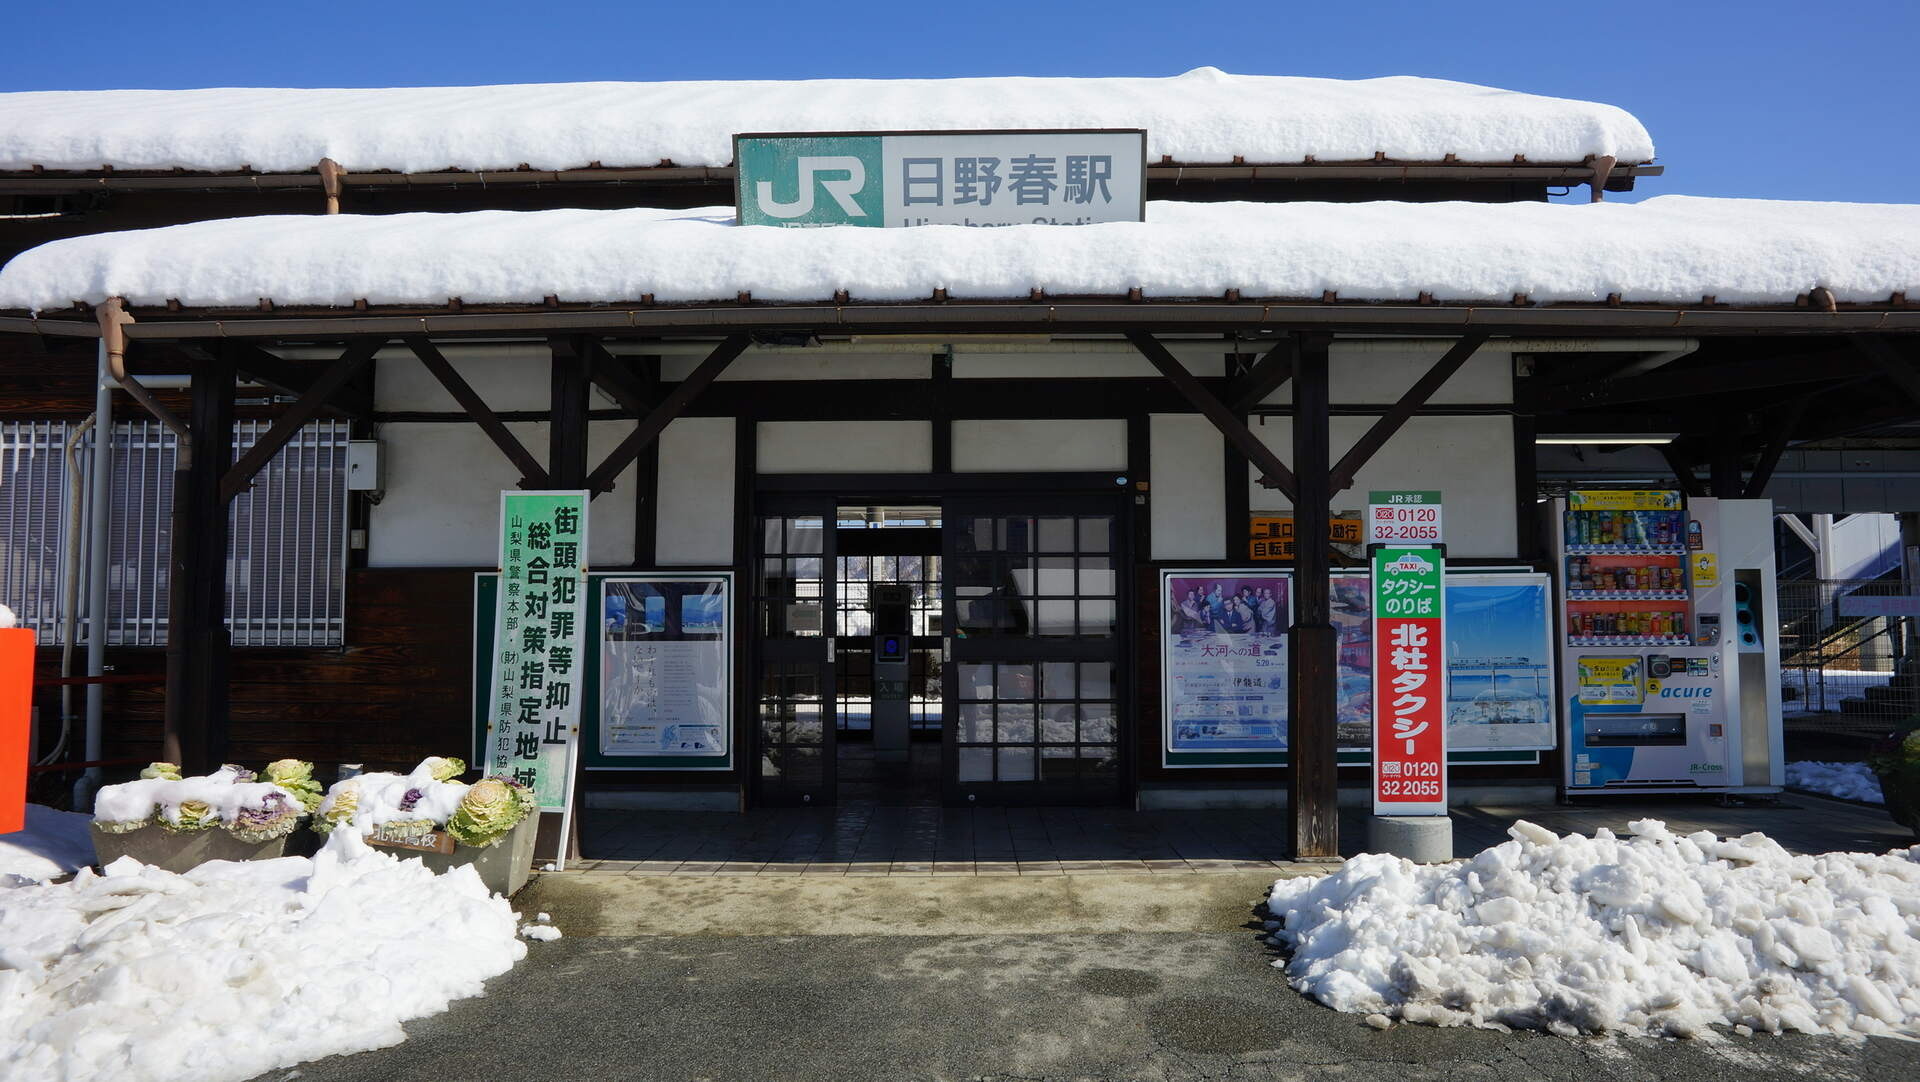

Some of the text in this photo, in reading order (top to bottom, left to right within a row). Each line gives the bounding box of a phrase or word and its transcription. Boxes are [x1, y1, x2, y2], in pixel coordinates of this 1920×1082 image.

[756, 156, 867, 218] JR
[902, 154, 1113, 206] 日野春駅
[1398, 509, 1436, 521] 0120
[1375, 526, 1438, 539] 32-2055
[1382, 578, 1436, 595] タクシー
[1385, 597, 1432, 614] のりば
[542, 506, 579, 745] 街頭犯罪等抑止
[513, 521, 551, 794] 総合対策指定地域
[1201, 643, 1262, 657] 大河への道
[1391, 623, 1429, 755] 北杜タクシー
[1661, 687, 1713, 698] acure
[1403, 762, 1439, 776] 0120
[1690, 763, 1723, 771] JR-Cross
[1382, 780, 1439, 795] 32 2055
